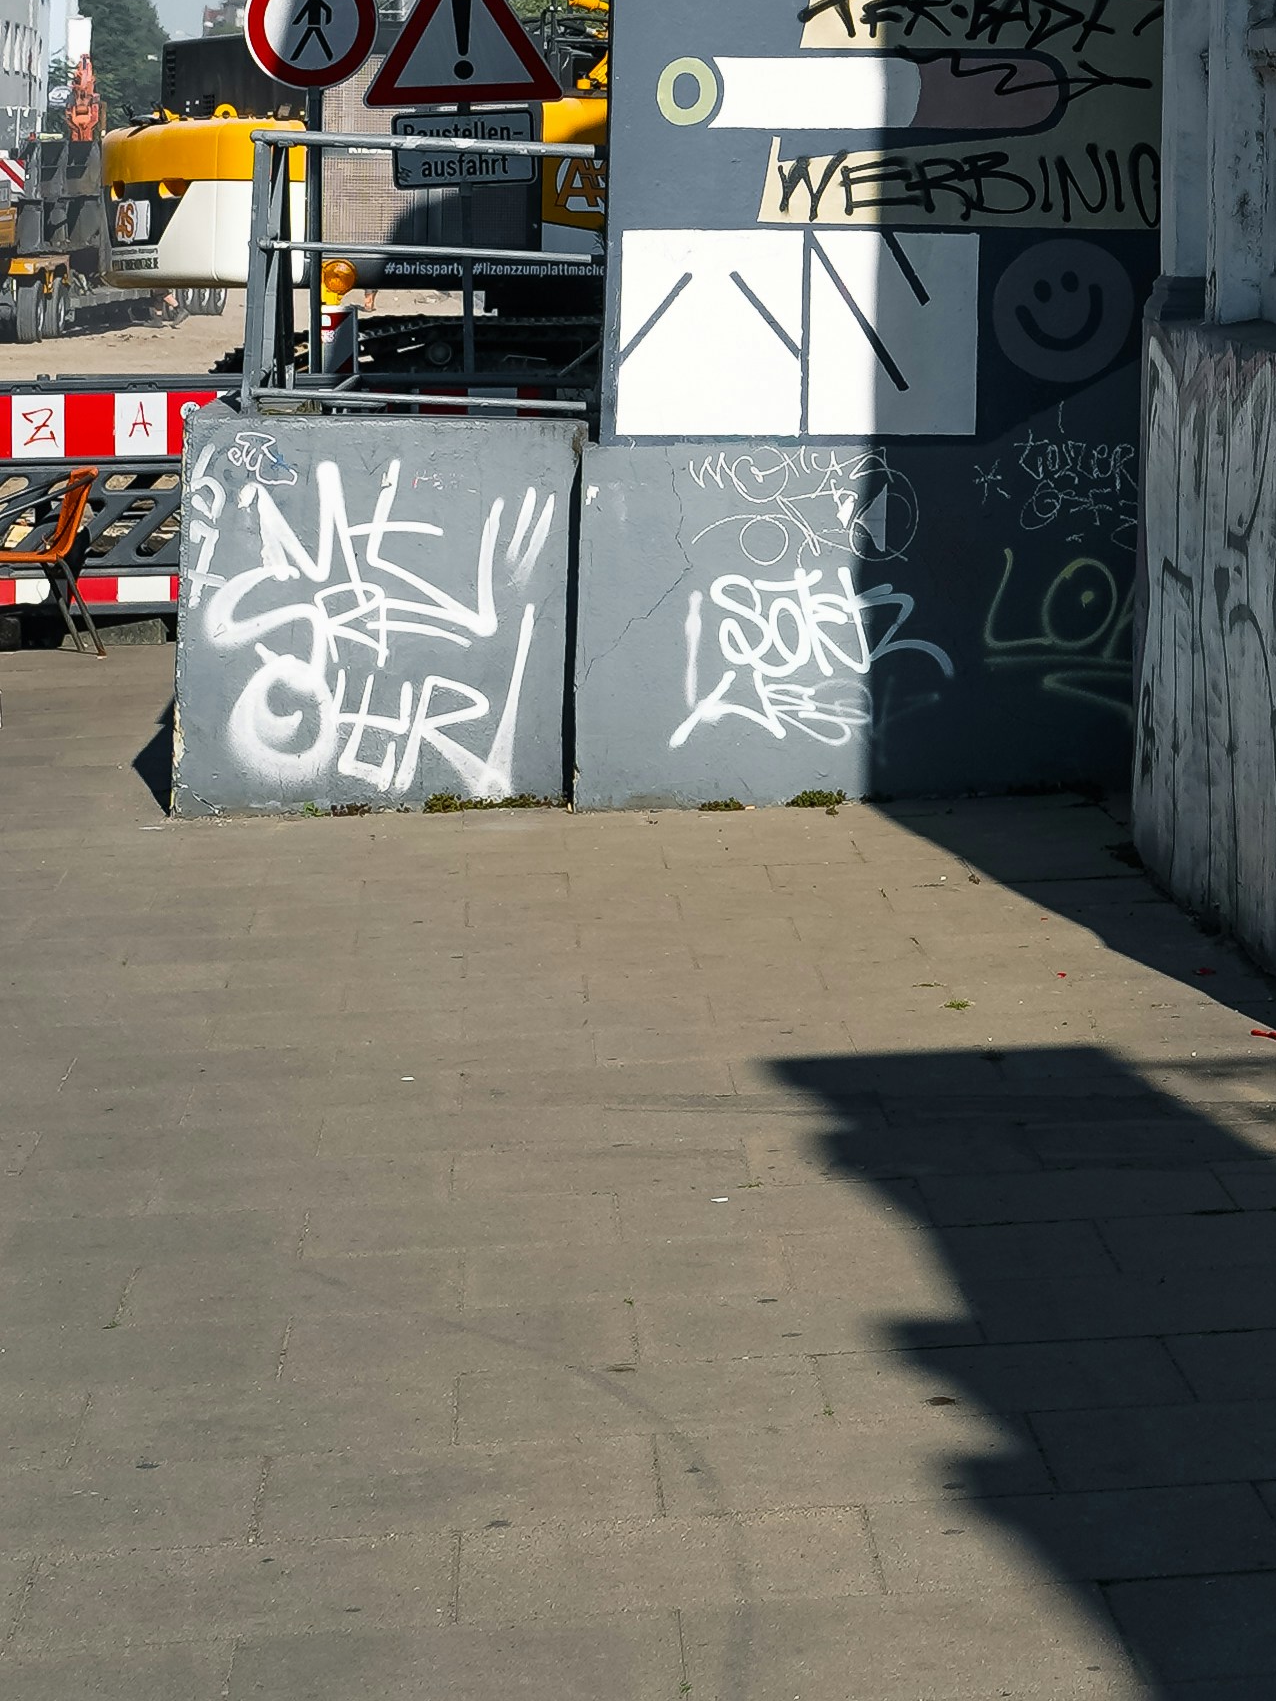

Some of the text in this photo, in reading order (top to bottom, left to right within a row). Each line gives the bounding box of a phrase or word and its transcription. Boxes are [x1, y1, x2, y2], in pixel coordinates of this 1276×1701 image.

[421, 153, 510, 179] ausfahrt
[384, 261, 464, 277] #abrissparty
[128, 400, 153, 438] A
